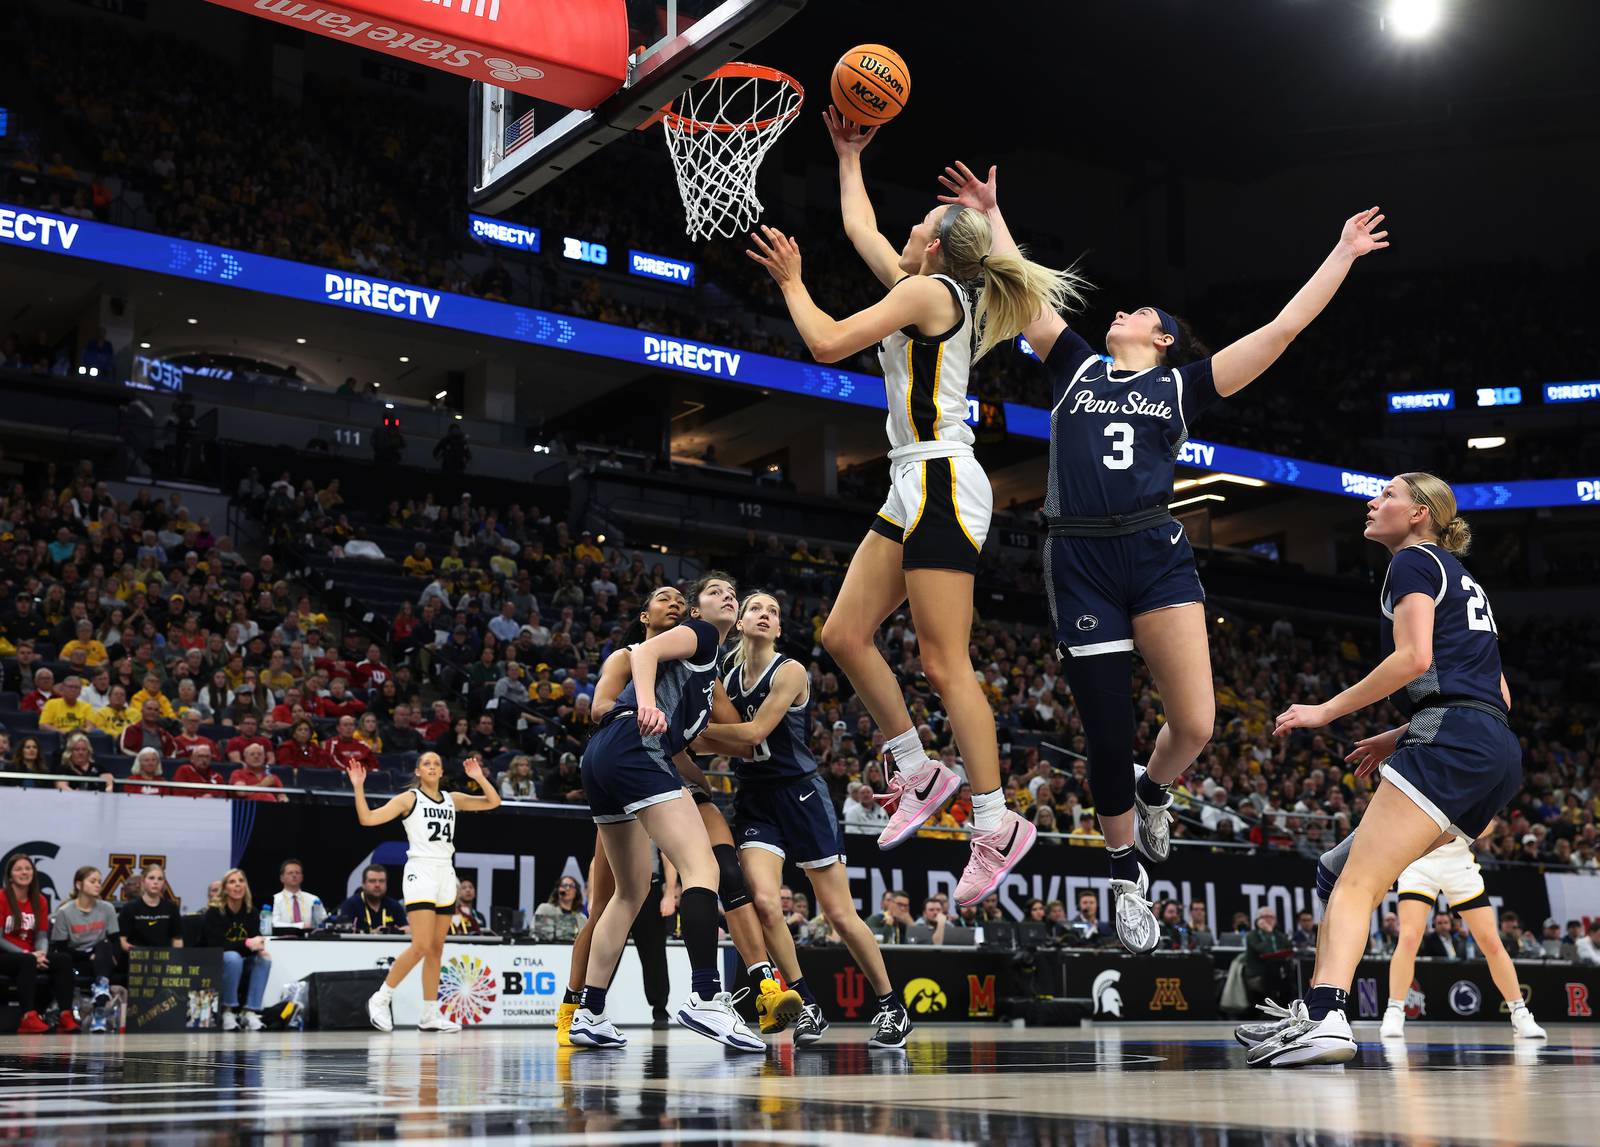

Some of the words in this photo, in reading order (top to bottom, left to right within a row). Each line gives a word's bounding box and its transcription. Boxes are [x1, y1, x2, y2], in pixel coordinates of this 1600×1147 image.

[859, 55, 904, 97] Wilson
[473, 219, 535, 245] DIRECTV
[632, 255, 690, 281] DIRECTV
[325, 273, 440, 319] DIRECTV
[644, 336, 740, 376] DIRECTV
[1070, 389, 1120, 414] Penn
[1121, 391, 1172, 420] State
[1391, 393, 1450, 409] DIRECTV
[334, 429, 361, 446] 111
[1102, 422, 1135, 470] 3
[738, 501, 763, 518] 112
[423, 807, 454, 821] IOWA
[427, 821, 452, 843] 24
[523, 957, 544, 967] TIAA
[966, 974, 997, 1017] M
[1149, 977, 1189, 1011] M
[1357, 978, 1379, 1018] N
[1565, 982, 1592, 1017] R
[502, 1008, 556, 1017] TOURNAMENT
